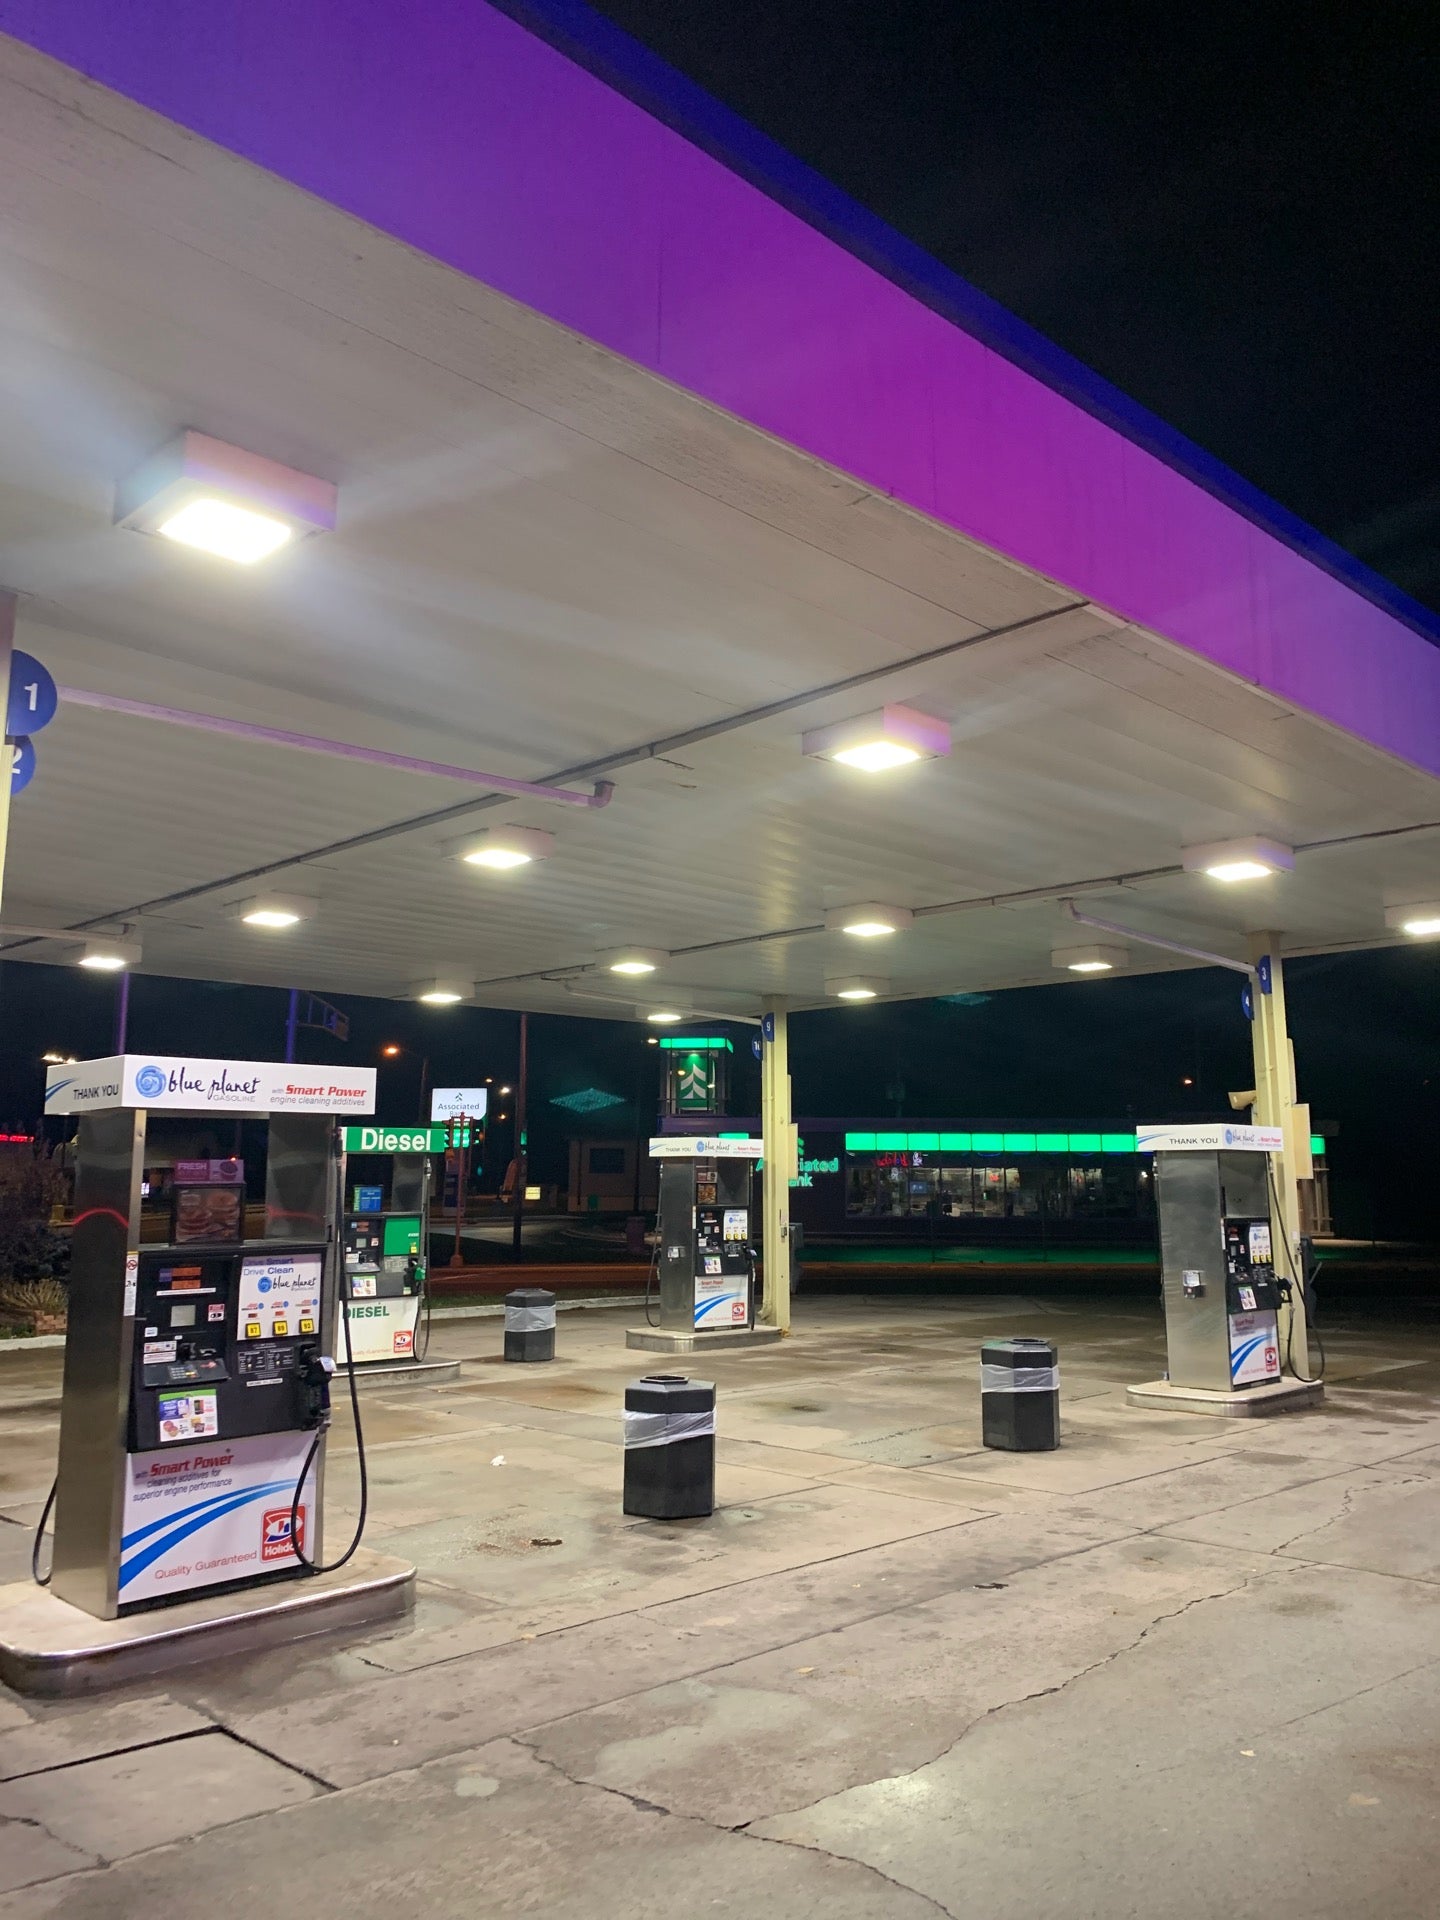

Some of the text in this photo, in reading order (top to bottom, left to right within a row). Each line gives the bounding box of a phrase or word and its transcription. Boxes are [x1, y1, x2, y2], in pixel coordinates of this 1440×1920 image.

[24, 683, 38, 711] 1
[1261, 967, 1267, 980] 3
[766, 1021, 771, 1032] 9
[168, 1066, 261, 1100] blue planet
[285, 1084, 325, 1097] Smart
[327, 1086, 367, 1097] Power
[73, 1084, 119, 1101] THANK YOU
[213, 1094, 256, 1103] GASOLINE
[270, 1096, 366, 1107] engine cleaning additives
[361, 1128, 431, 1151] Diesel
[177, 1162, 208, 1170] FRESH
[243, 1267, 294, 1276] Drive Clean
[272, 1274, 316, 1291] blue planet
[150, 1460, 191, 1477] Smart
[193, 1454, 234, 1470] Power
[146, 1476, 177, 1489] cleaning
[211, 1468, 222, 1477] for
[132, 1478, 233, 1503] superior engine performance
[154, 1551, 257, 1580] Quality Guaranteed
